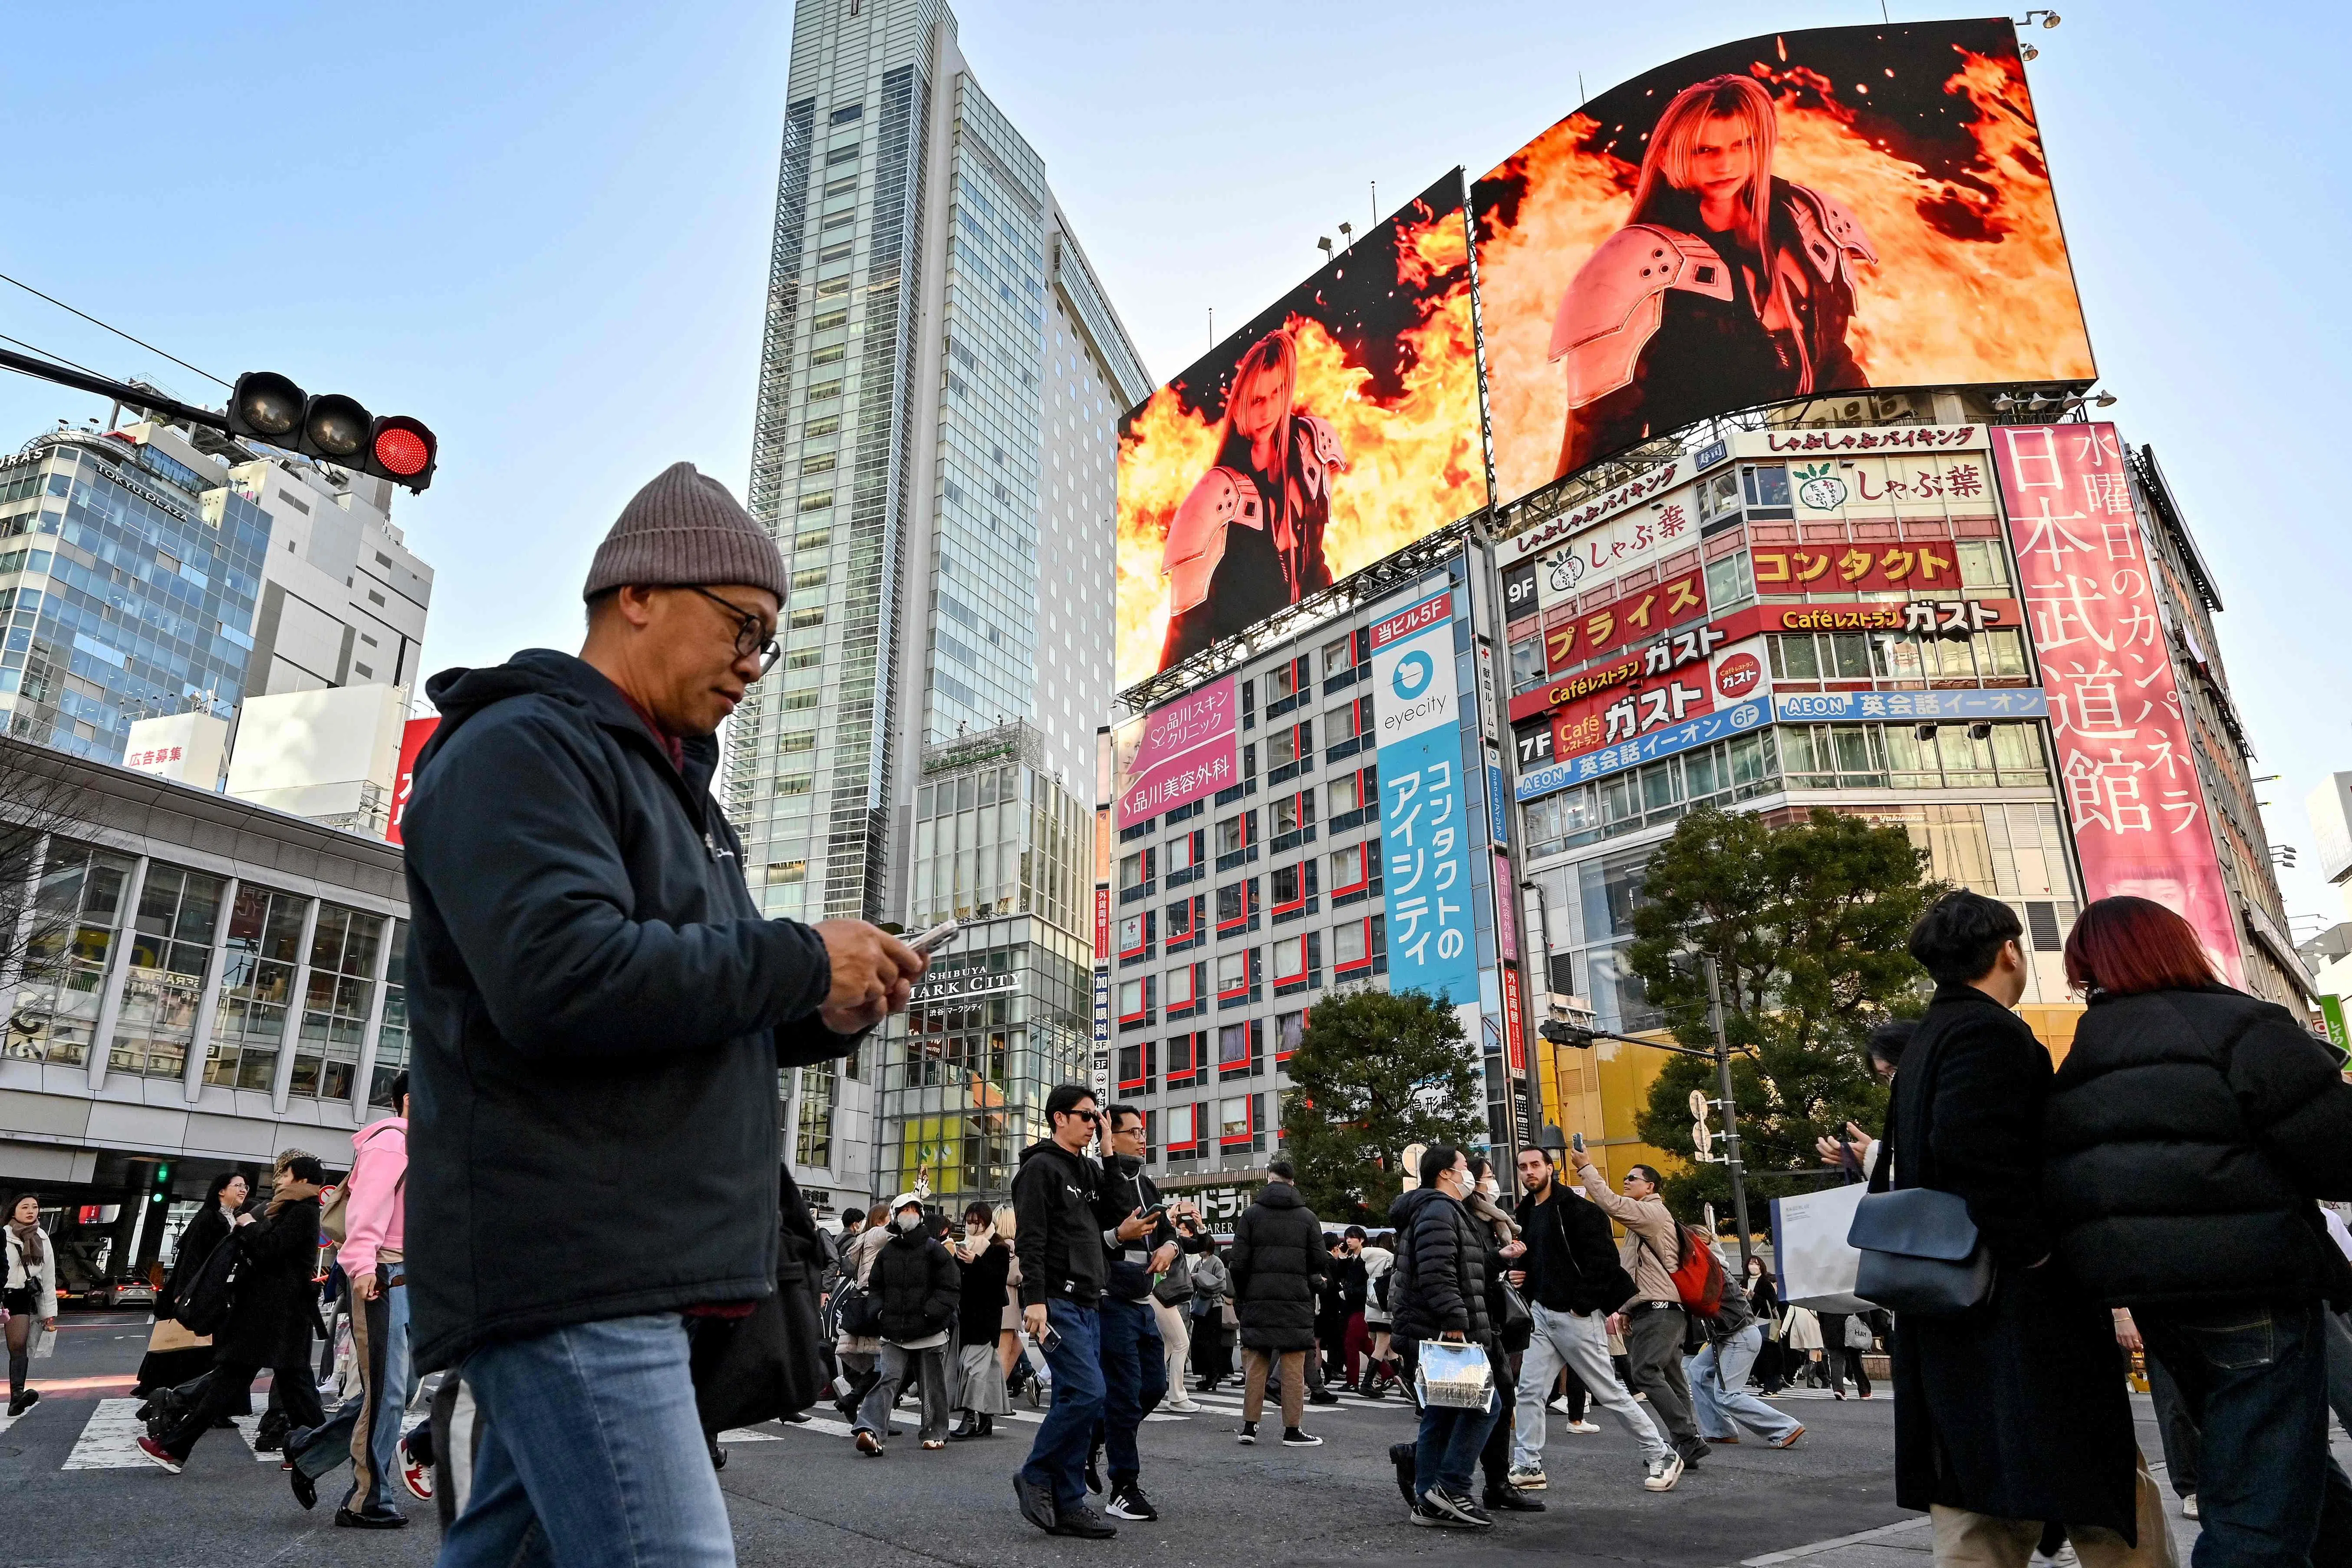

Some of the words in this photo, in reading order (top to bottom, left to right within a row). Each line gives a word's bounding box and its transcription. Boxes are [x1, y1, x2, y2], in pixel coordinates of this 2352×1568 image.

[1698, 442, 1724, 465] 寿司
[1769, 426, 1975, 451] しゃぶしゃぶバイキング
[97, 463, 141, 494] TOKYU
[146, 492, 187, 522] PLAZA
[1858, 464, 1983, 501] しゃぶ葉
[1517, 463, 1678, 553] しゃぶしゃぶバイキング
[1590, 504, 1687, 569] しゃぶ葉
[1755, 548, 1949, 582] コンタクト
[1508, 576, 1534, 603] 9F
[1378, 599, 1442, 643] 当ビル5F
[1548, 578, 1700, 662] プライス
[1905, 600, 1999, 632] ガスト
[2004, 426, 2151, 834] 日本武道館
[2073, 425, 2198, 833] 水曜日のカンパネラ
[1645, 626, 1724, 676] ガスト
[1482, 667, 1495, 728] 献血ルーム
[1723, 670, 1756, 690] ガスト
[1167, 691, 1229, 731] 品川スキン
[1384, 695, 1446, 731] eyecity
[1604, 682, 1701, 744] ガスト
[1788, 698, 1845, 714] AEON
[1860, 693, 2039, 717] 英会話イーオン
[1168, 713, 1222, 749] クリニック
[1561, 713, 1599, 741] Café
[1562, 732, 1600, 753] レストラン
[128, 746, 182, 768] 広告募集
[925, 752, 970, 770] MARK
[973, 741, 1012, 758] CITY
[1519, 731, 1552, 762] 7F
[1522, 768, 1564, 793] AEON
[1579, 718, 1722, 779] 英会話イーオン
[1734, 707, 1755, 725] 6F
[1133, 755, 1230, 814] 品川美容外科
[1492, 769, 1502, 839] コンタクトのアイシティ
[1387, 770, 1432, 965] アイシティ
[1428, 760, 1464, 959] コンタクトの
[1098, 891, 1107, 928] 外貨両替
[1500, 875, 1512, 943] 品川美容外科
[1505, 948, 1514, 958] 4F
[929, 965, 987, 982] SHIBUYA
[970, 972, 1023, 990] CITY
[1095, 976, 1107, 1037] 加藤眼科
[1507, 972, 1519, 1024] 外貨両替
[2329, 1021, 2344, 1044] レイク
[1514, 1069, 1523, 1078] 7F
[1096, 1087, 1106, 1108] 内科
[1206, 1222, 1234, 1234] ARER
[1855, 1329, 1867, 1337] HAY
